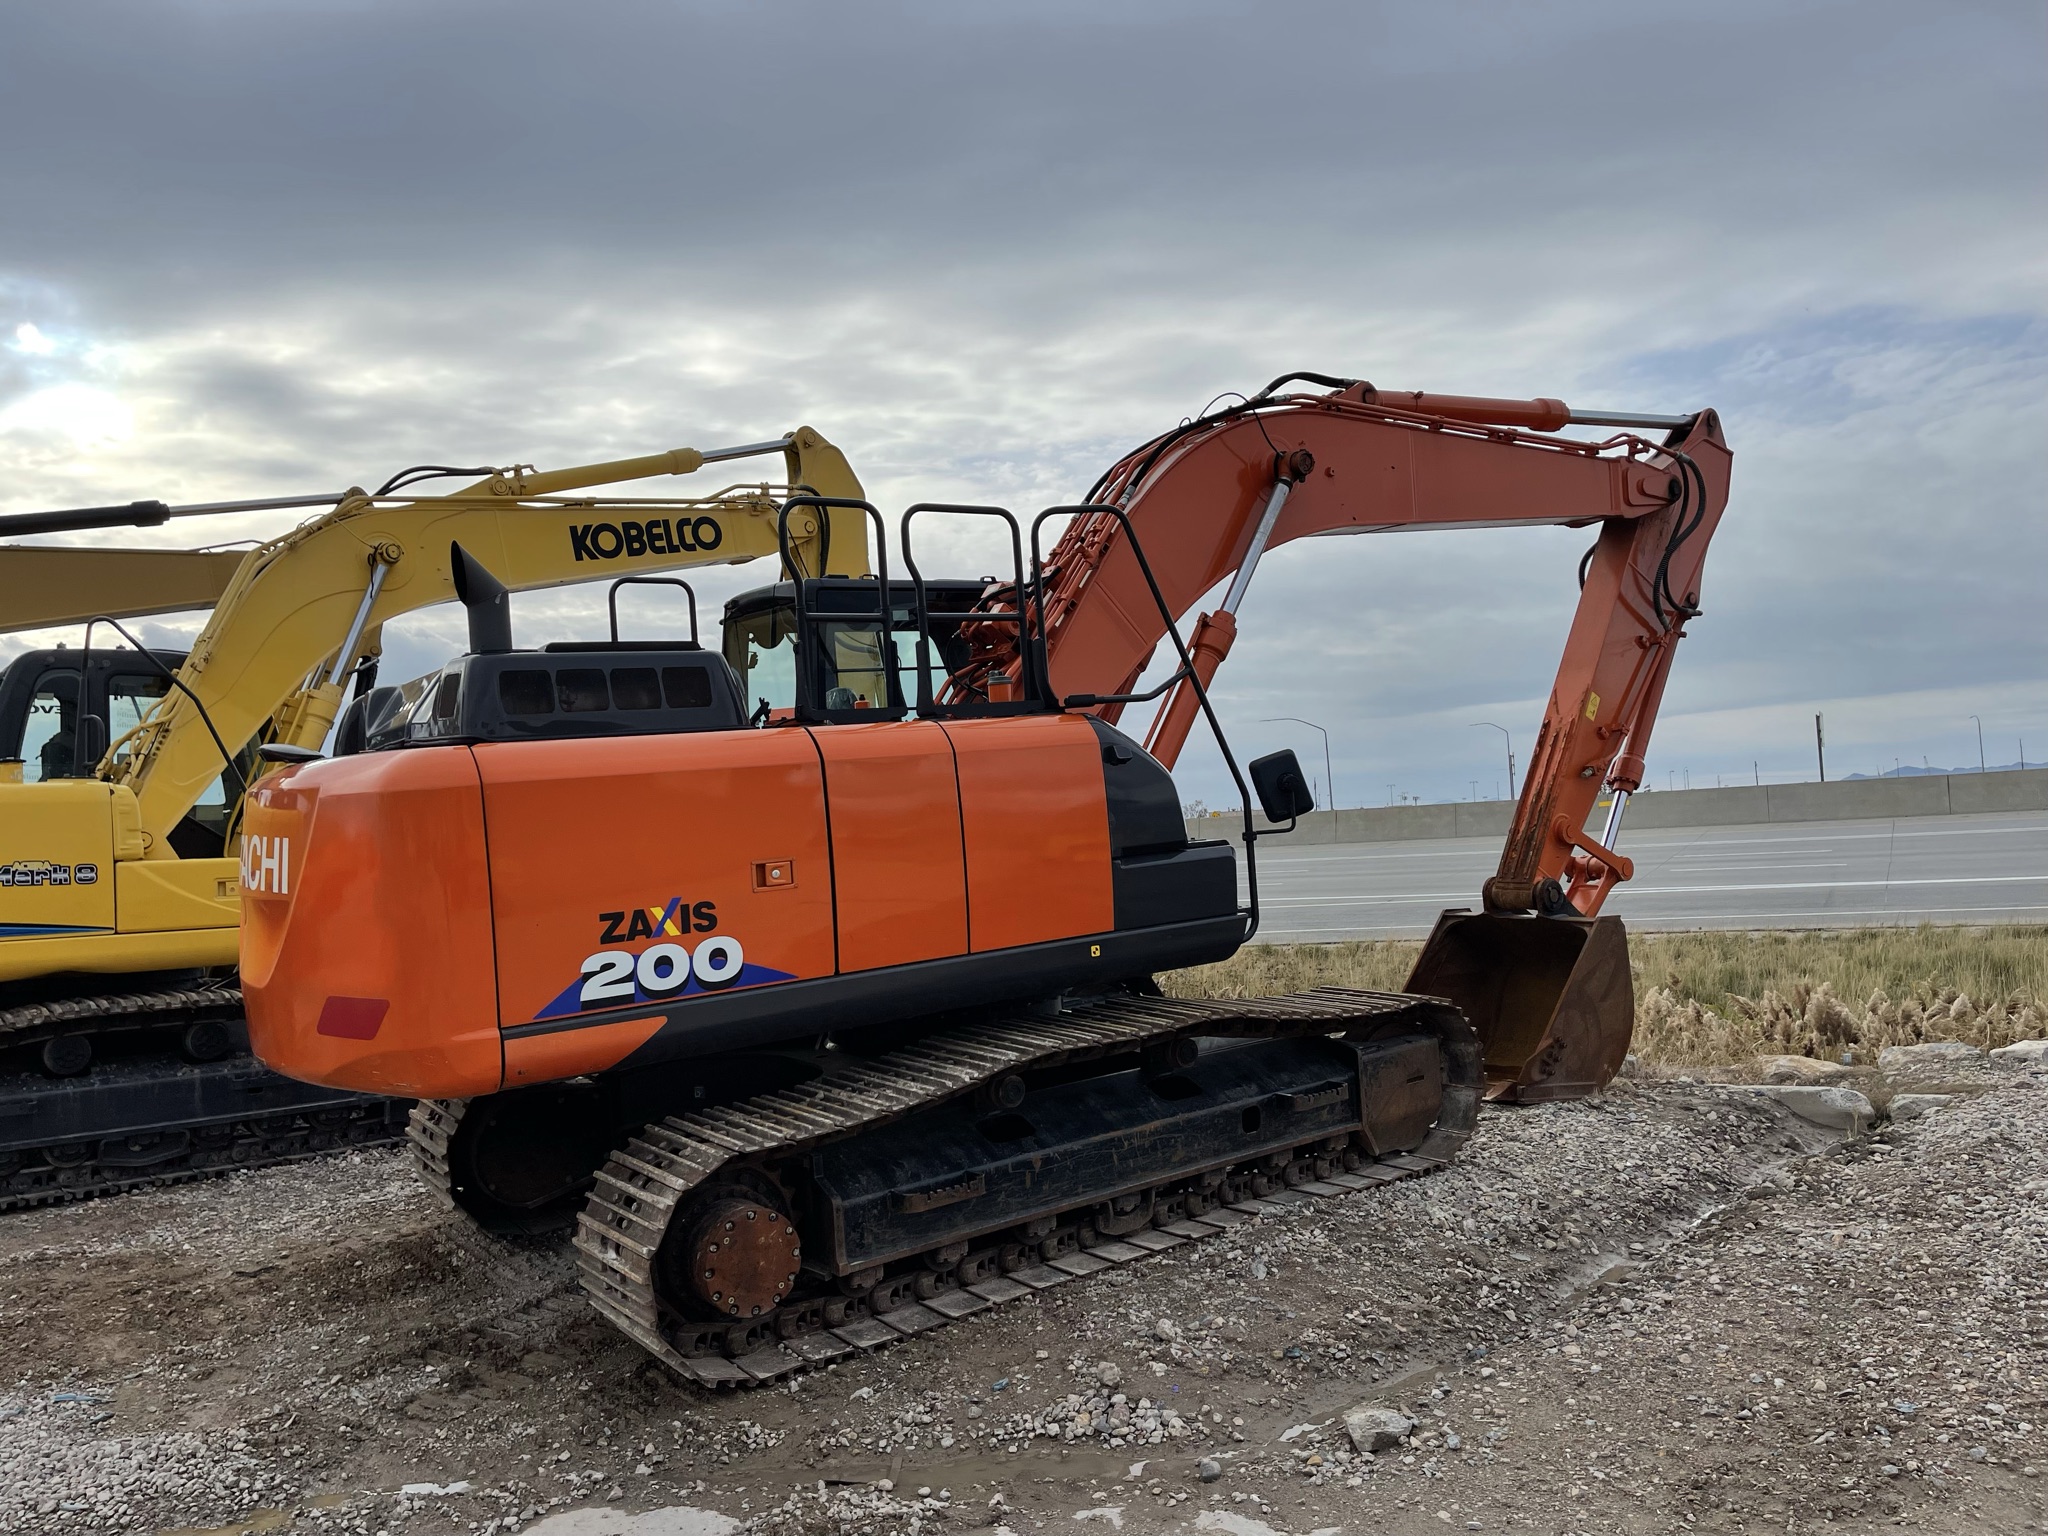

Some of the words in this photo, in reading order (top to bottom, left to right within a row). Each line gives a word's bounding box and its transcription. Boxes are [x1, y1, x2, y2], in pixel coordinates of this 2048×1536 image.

[569, 516, 722, 561] KOBELCO
[74, 863, 98, 885] 8
[240, 834, 289, 894] ACHI
[600, 897, 718, 945] ZAXIS
[580, 936, 744, 1009] 200
